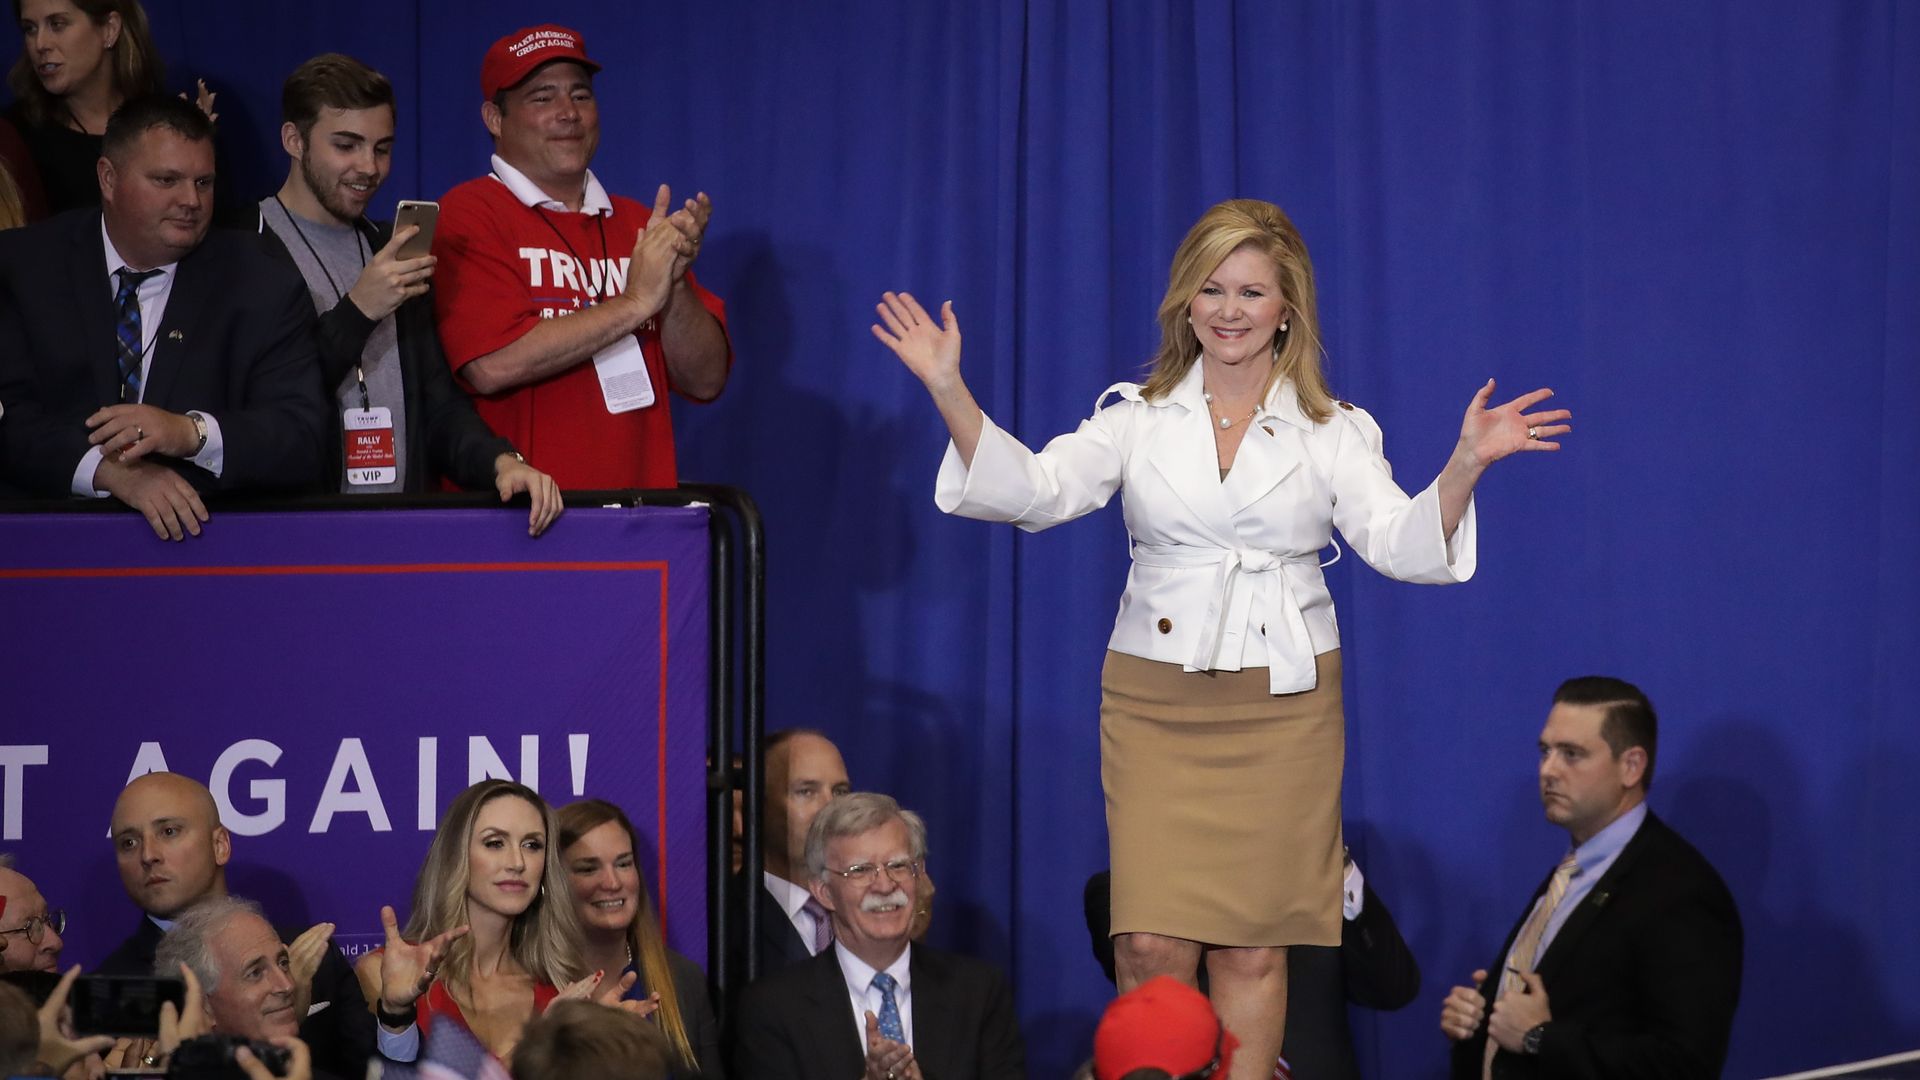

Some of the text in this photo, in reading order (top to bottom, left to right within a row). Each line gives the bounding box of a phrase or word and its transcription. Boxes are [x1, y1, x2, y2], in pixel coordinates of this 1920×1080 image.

[508, 31, 576, 52] MAKE AMERICA
[516, 39, 575, 57] GREAT AGAIN
[518, 247, 631, 297] TRUM
[357, 436, 381, 445] RALLY
[362, 470, 381, 481] VIP
